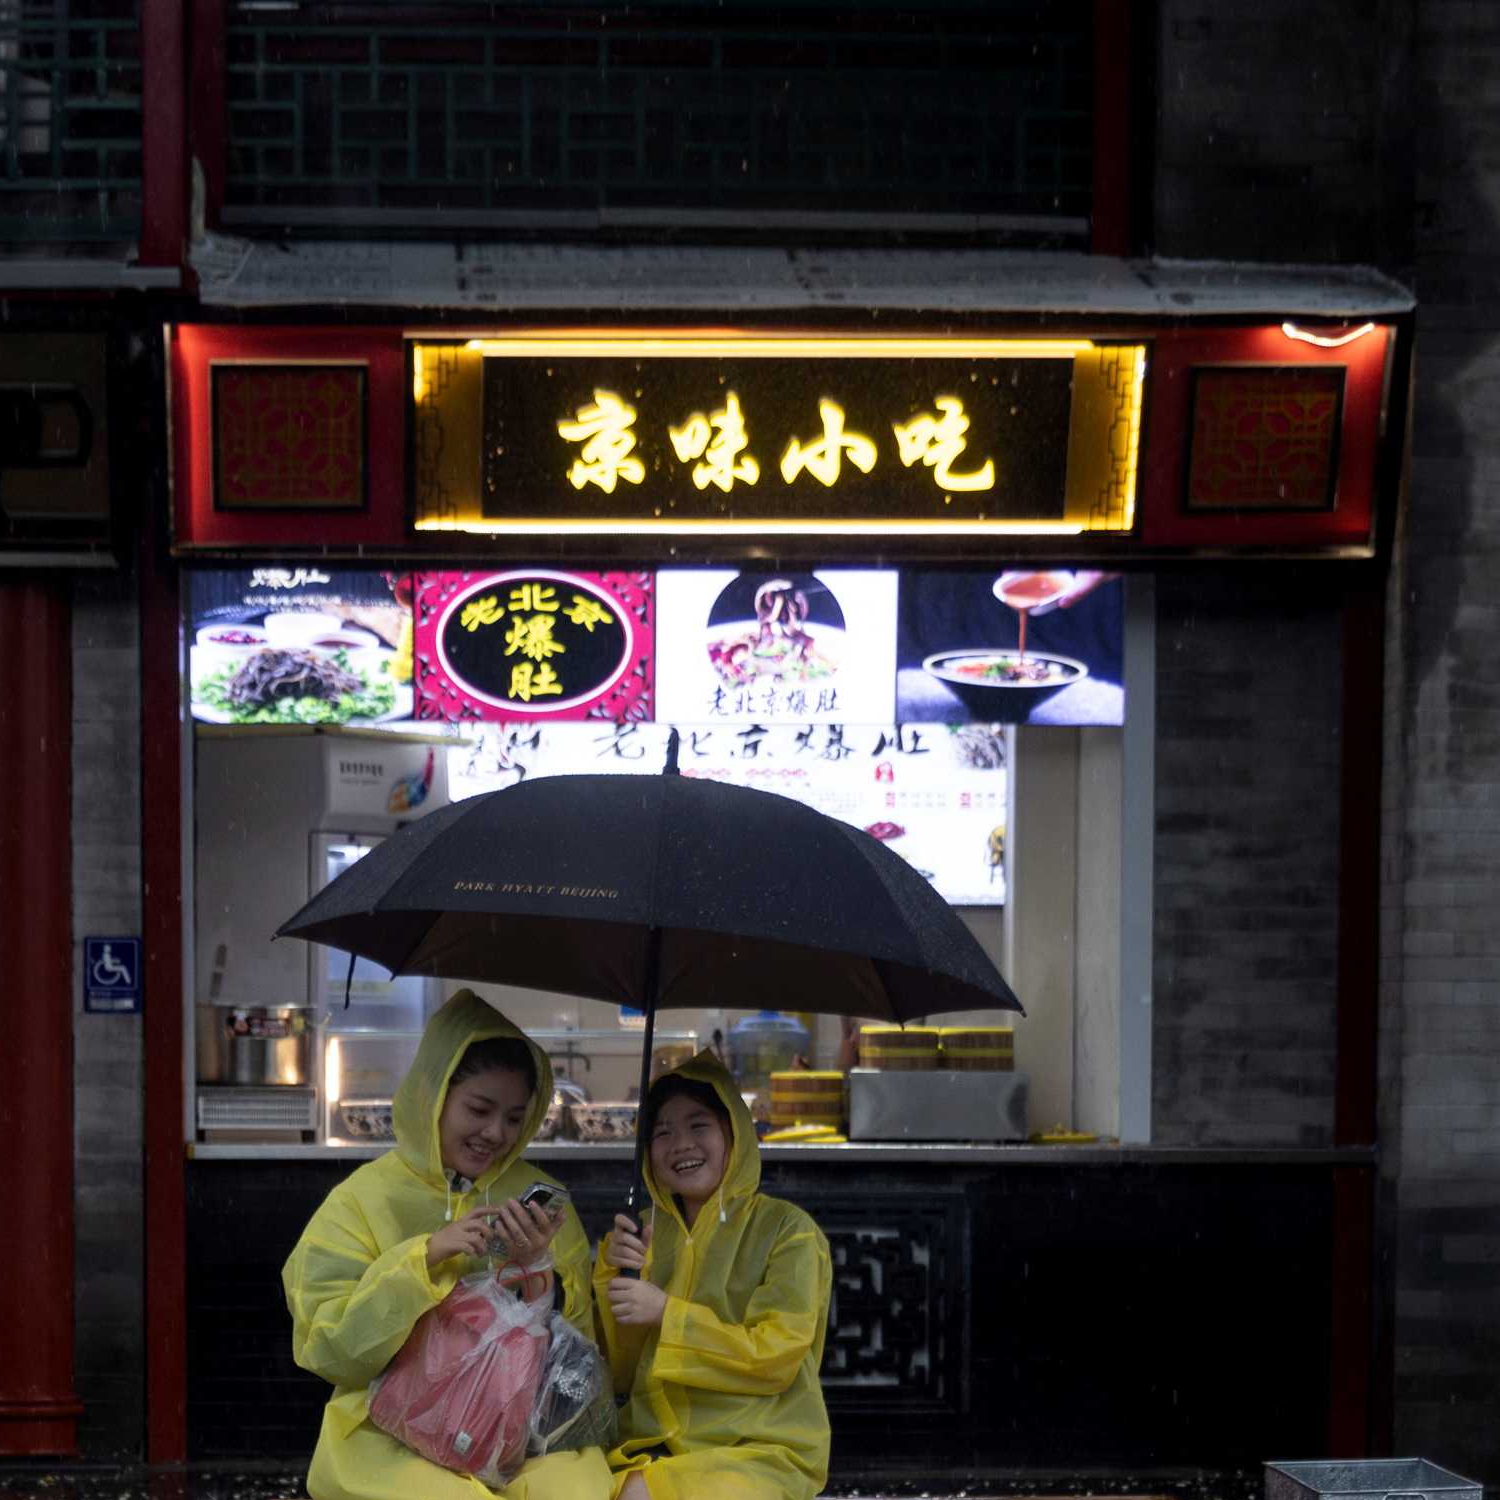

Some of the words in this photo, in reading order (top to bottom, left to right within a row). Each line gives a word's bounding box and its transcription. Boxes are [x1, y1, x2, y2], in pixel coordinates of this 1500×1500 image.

[557, 388, 996, 494] 京味小吃
[460, 583, 614, 633] 老北京
[504, 613, 566, 702] 爆肚
[708, 684, 843, 716] 老北京爆肚
[453, 880, 494, 891] PARK
[501, 883, 554, 894] HYATT
[560, 887, 619, 899] BEIJING
